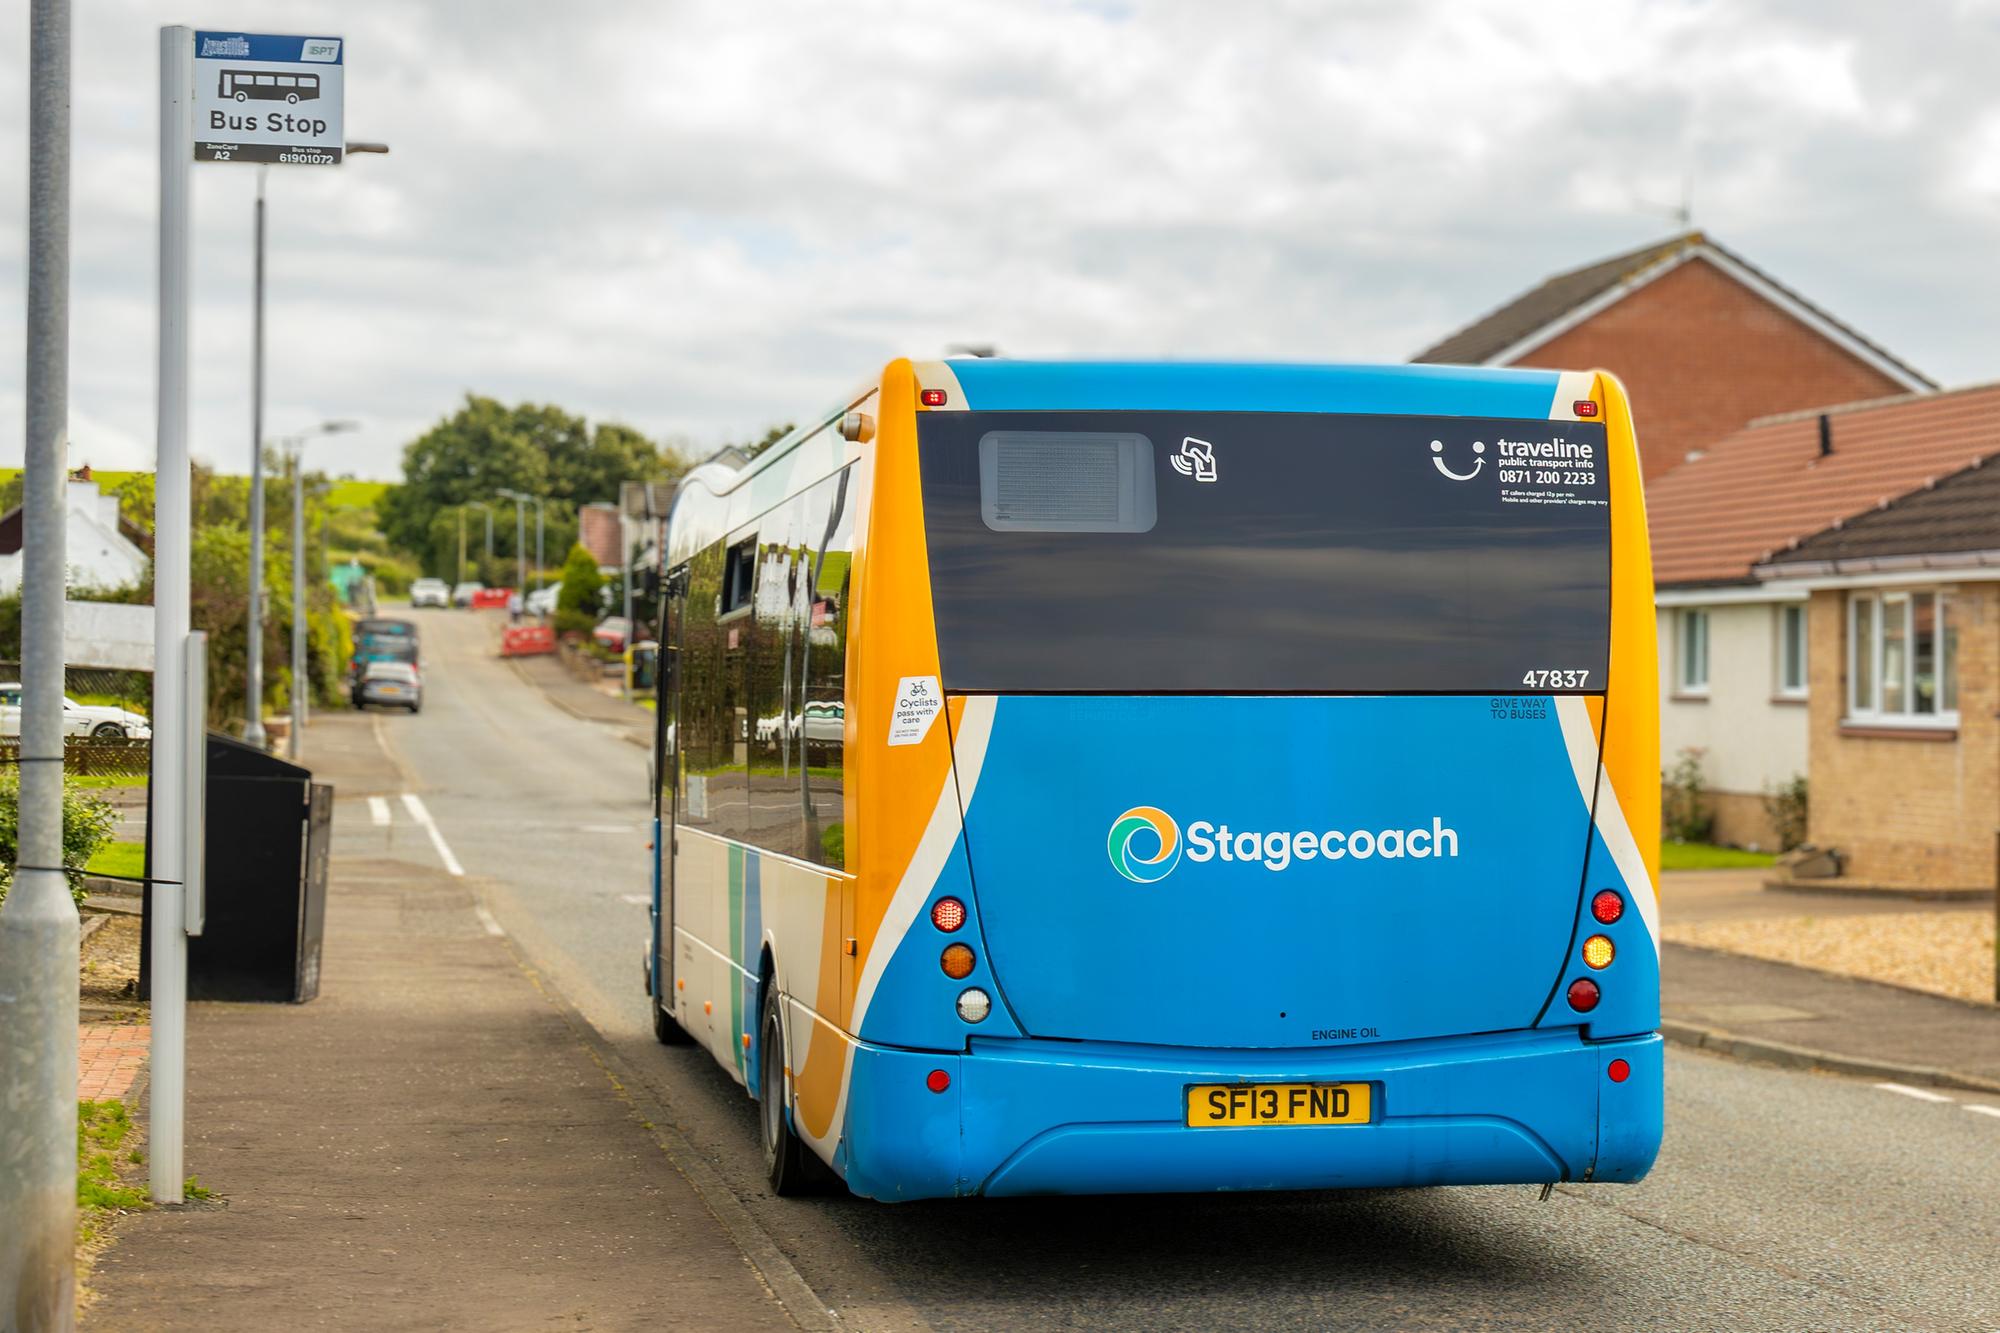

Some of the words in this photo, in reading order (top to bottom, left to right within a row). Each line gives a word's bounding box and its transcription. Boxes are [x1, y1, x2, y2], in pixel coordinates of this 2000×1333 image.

[210, 110, 257, 131] Bus
[266, 112, 327, 137] Stop
[214, 150, 231, 160] A2
[279, 153, 334, 164] 61901072
[1497, 437, 1593, 459] traveline
[1498, 457, 1528, 468] public
[1529, 458, 1573, 469] transport
[1575, 458, 1594, 469] info
[1499, 469, 1531, 483] 0871
[1535, 470, 1560, 484] 200
[1563, 471, 1596, 485] 2233
[1522, 670, 1590, 688] 47837
[900, 697, 938, 709] Cyclists
[1490, 698, 1518, 709] GIVE
[1519, 698, 1548, 709] WAY
[897, 710, 915, 719] pass
[916, 707, 934, 716] with
[1490, 709, 1507, 719] TO
[1510, 709, 1546, 720] BUSES
[1186, 816, 1459, 871] Stagecoach
[1311, 1028, 1358, 1041] ENGINE
[1360, 1027, 1381, 1039] OIL
[1208, 1089, 1279, 1120] SF13
[1288, 1088, 1350, 1119] FND
